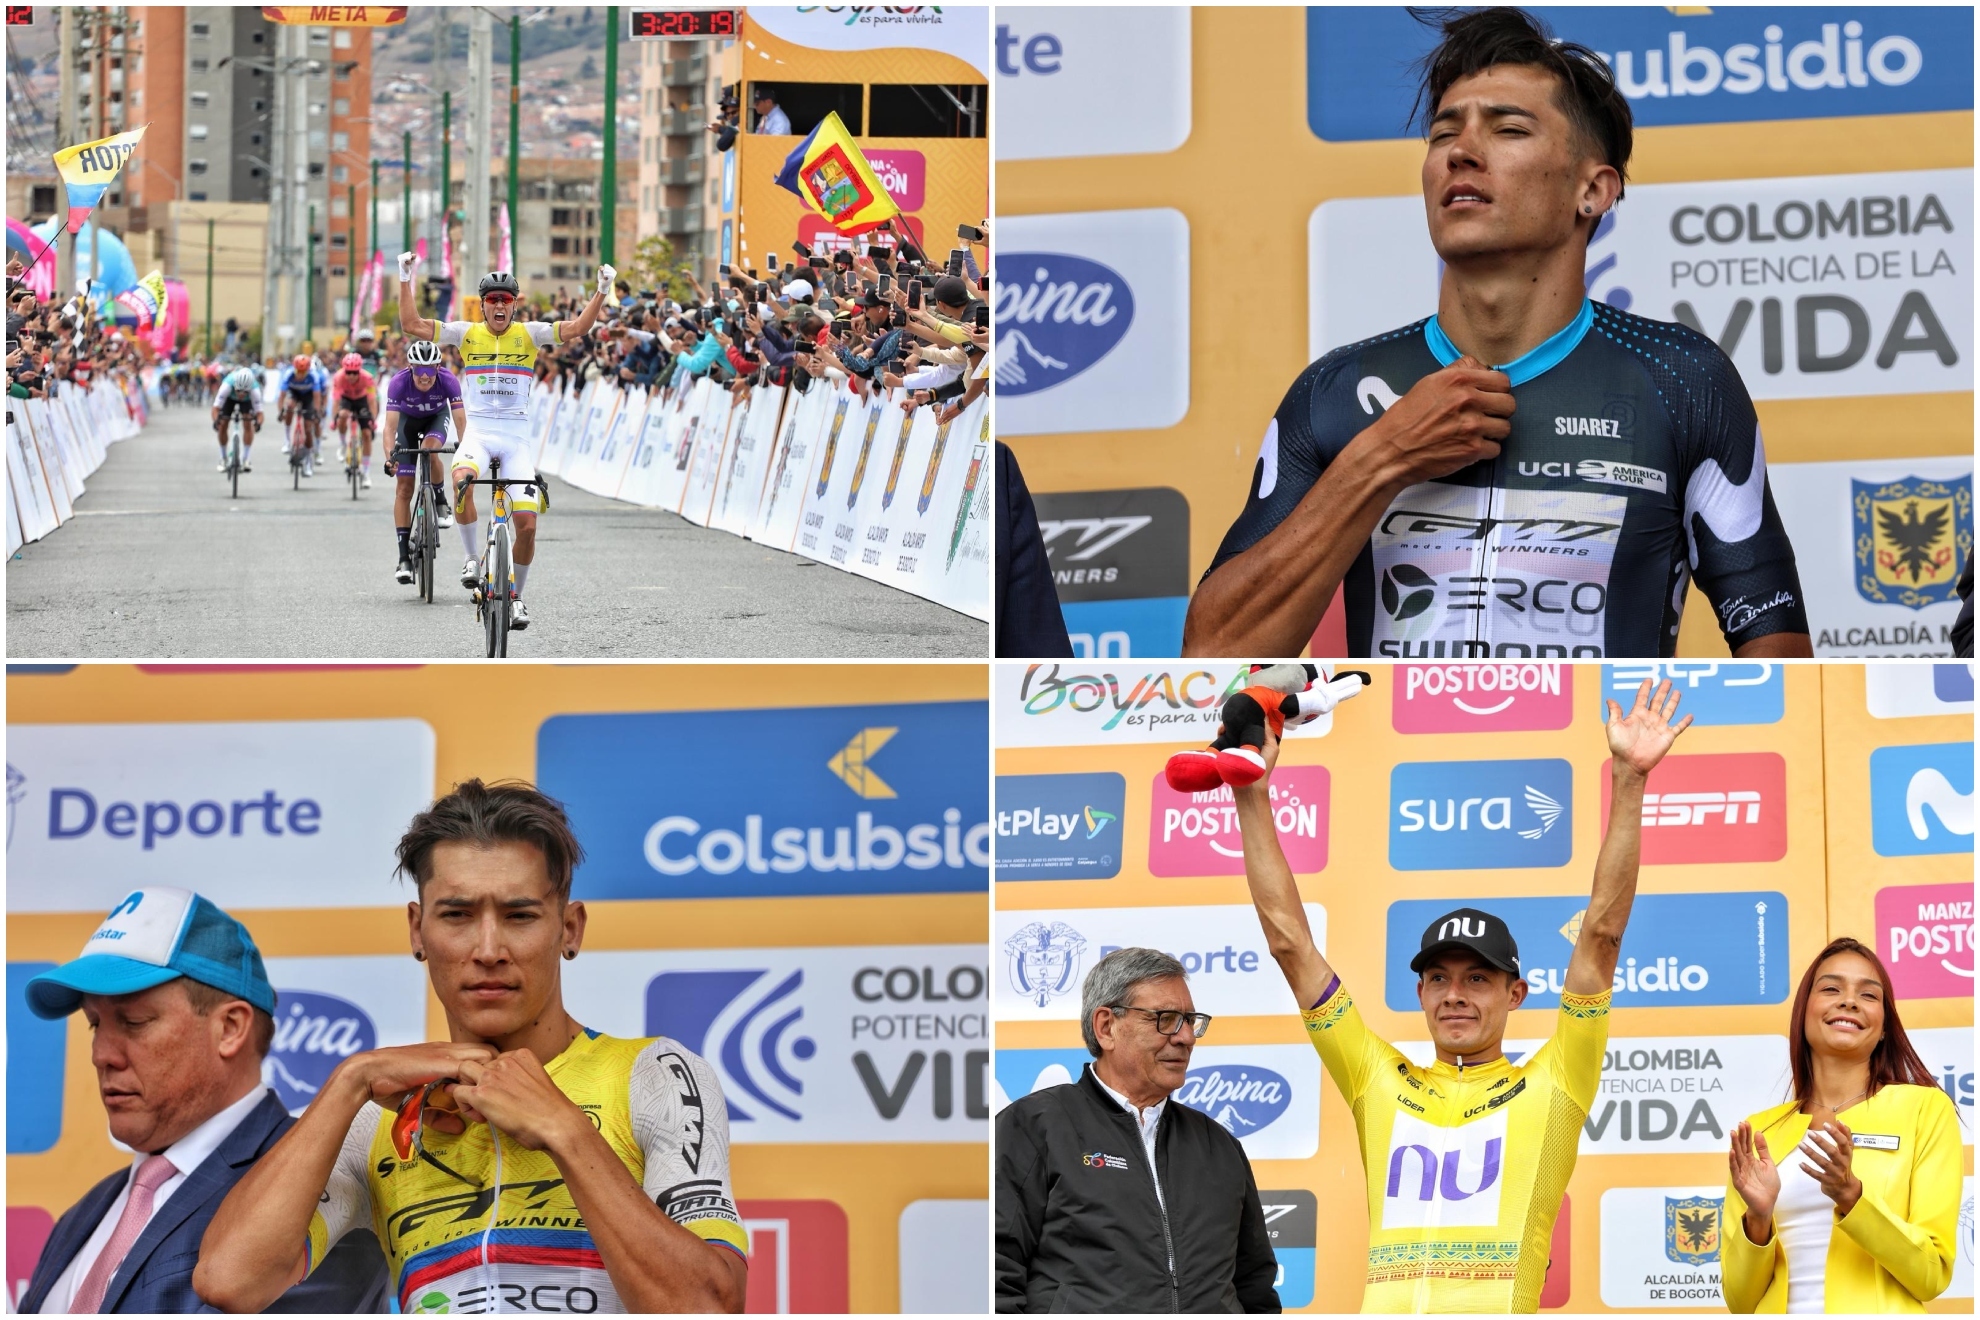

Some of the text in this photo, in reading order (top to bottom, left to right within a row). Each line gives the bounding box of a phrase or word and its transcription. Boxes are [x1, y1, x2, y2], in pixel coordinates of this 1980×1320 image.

[309, 6, 367, 22] META
[874, 16, 903, 27] para
[906, 14, 943, 24] vivirla
[1670, 193, 1954, 246] COLOMBIA
[1671, 248, 1956, 289] POTENCIA DE LA
[1672, 290, 1959, 376] VIDA
[1555, 416, 1622, 439] SUAREZ
[1518, 461, 1571, 477] UCI
[1612, 466, 1663, 483] AMERICA
[1613, 474, 1644, 486] TOUR
[1491, 545, 1590, 557] WINNERS
[1051, 567, 1119, 585] NERS
[1447, 576, 1606, 615] ERCO
[1817, 621, 1932, 649] ALCALDÍA
[1406, 664, 1561, 700] POSTOBON
[1126, 712, 1145, 725] es
[1149, 711, 1197, 731] para
[47, 787, 322, 850] Deporte
[1399, 797, 1511, 832] sura
[1641, 791, 1761, 827] ESPN
[995, 807, 1080, 840] tPlay
[1164, 804, 1317, 843] POSTON
[1918, 901, 1974, 921] MANZ
[1437, 917, 1486, 941] nu
[852, 964, 989, 1001] COLO
[1527, 956, 1709, 995] susidio
[852, 1013, 989, 1041] POTENCI
[1602, 1048, 1723, 1072] OLOMBIA
[1172, 1071, 1283, 1111] alpina
[1600, 1076, 1724, 1093] TENCIA DE LA
[1397, 1094, 1425, 1113] LÍDER
[1464, 1104, 1486, 1119] UCI
[1585, 1098, 1724, 1142] VIDA
[1387, 1137, 1502, 1201] nu
[444, 1227, 476, 1240] for
[1644, 1273, 1705, 1286] ALCALDÍA
[458, 1284, 598, 1314] ERCO
[1650, 1286, 1721, 1300] DE BOGOTÁ
